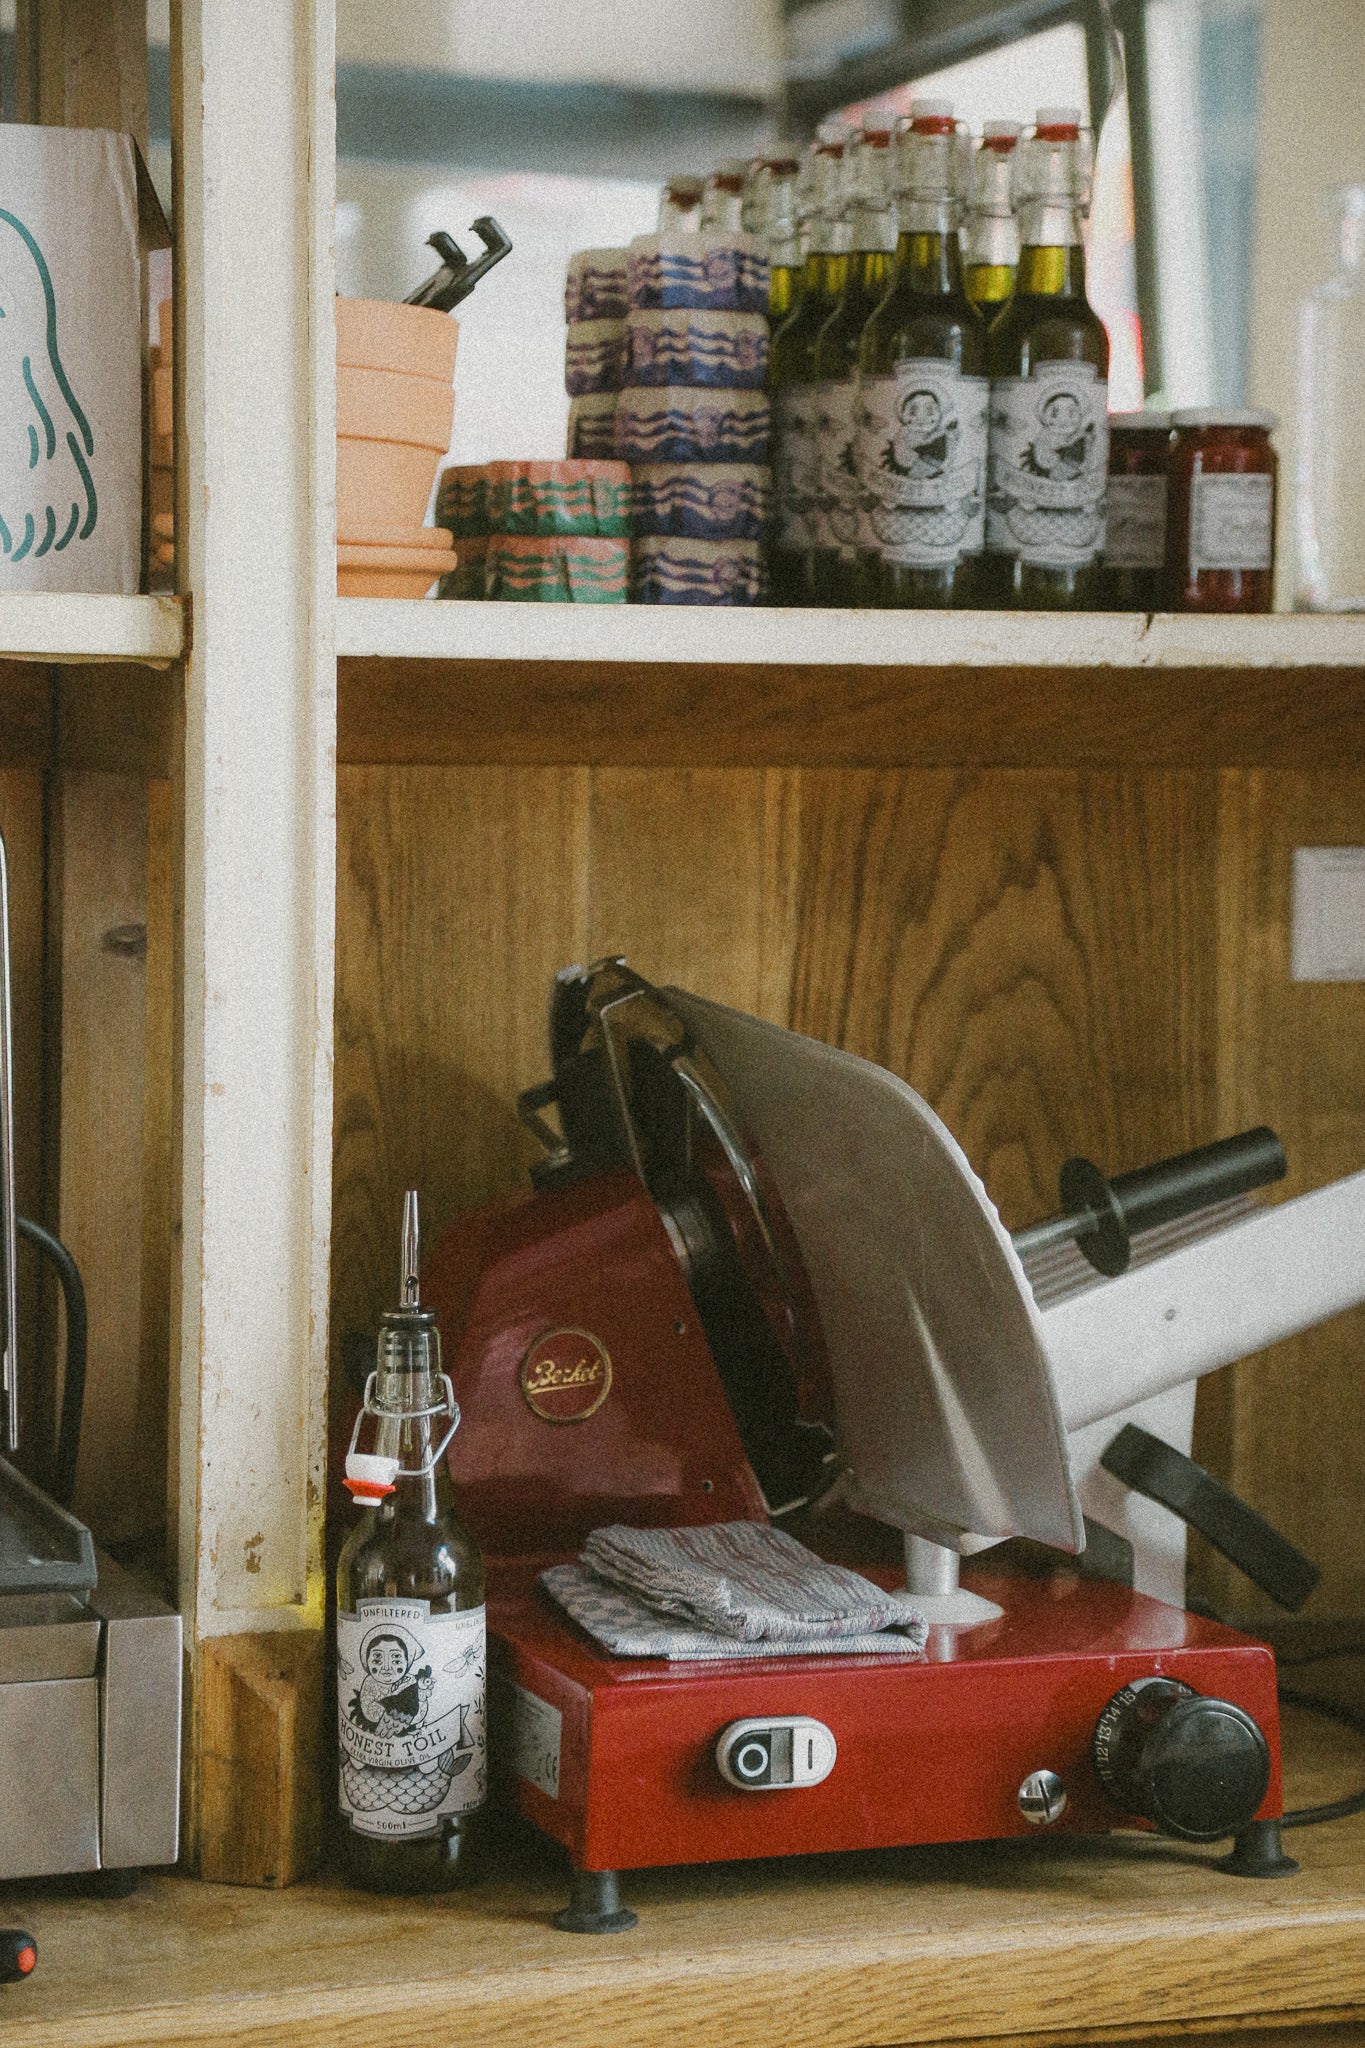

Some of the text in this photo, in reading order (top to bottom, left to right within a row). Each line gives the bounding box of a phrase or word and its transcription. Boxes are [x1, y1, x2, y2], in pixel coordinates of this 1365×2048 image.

[363, 1607, 421, 1620] UNFILTERED
[1120, 1690, 1136, 1706] 15
[1106, 1706, 1121, 1722] 14
[340, 1718, 447, 1758] HONEST TOIL
[1099, 1725, 1112, 1742] 13
[368, 1757, 393, 1767] VIRGIN
[395, 1757, 416, 1767] OLIVE
[419, 1752, 432, 1761] OIL
[1097, 1747, 1109, 1762] 12
[376, 1820, 407, 1830] 500ml
